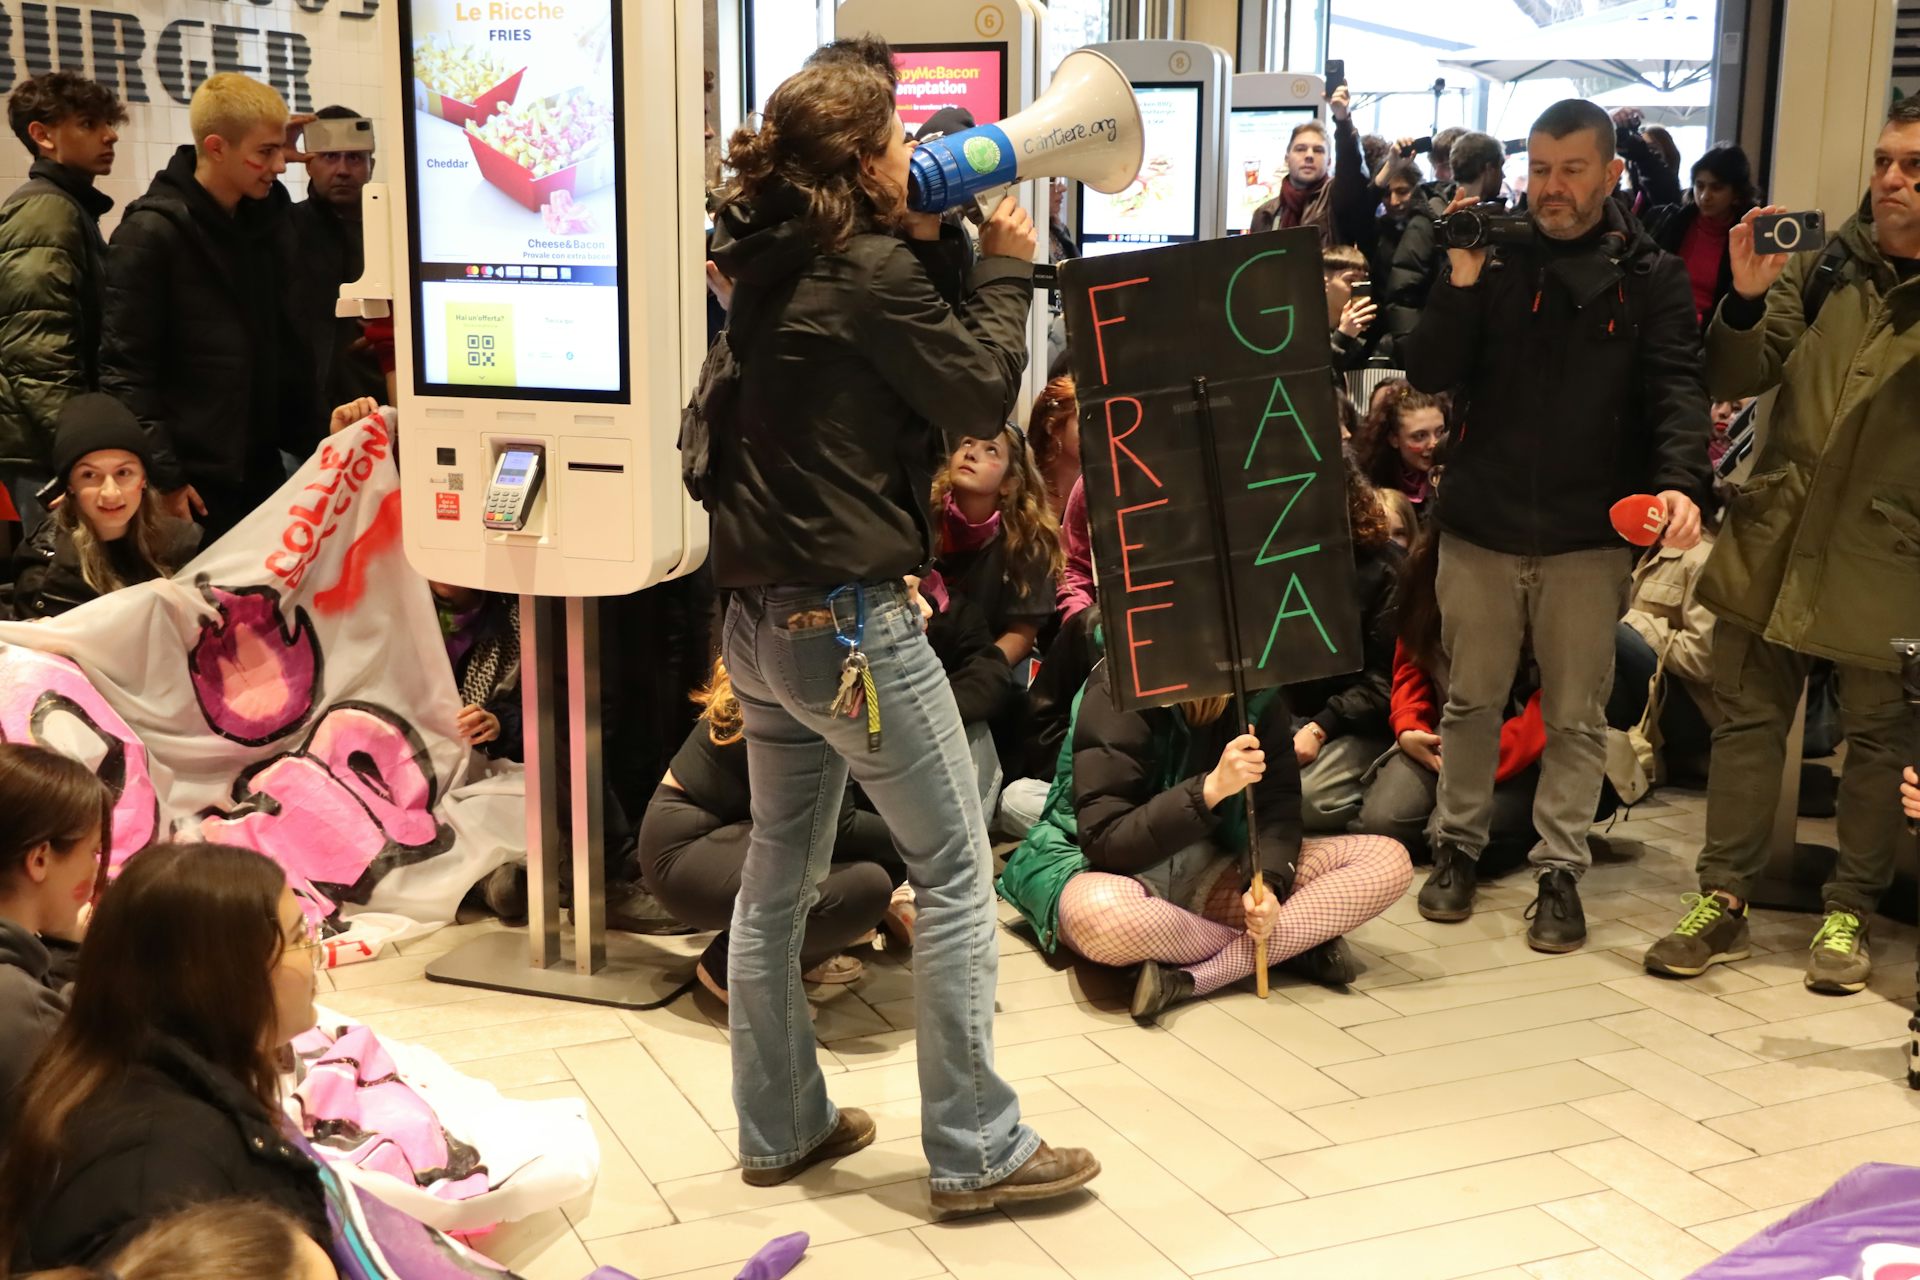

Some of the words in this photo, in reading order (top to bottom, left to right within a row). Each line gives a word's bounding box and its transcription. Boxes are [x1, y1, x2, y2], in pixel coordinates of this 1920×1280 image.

[456, 2, 481, 21] Le
[489, 1, 564, 20] Ricche
[984, 14, 994, 28] 6
[489, 29, 532, 41] FRIES
[0, 2, 314, 113] URGER
[1175, 57, 1184, 69] 8
[1294, 83, 1306, 93] 10
[426, 159, 469, 169] Cheddar
[528, 239, 605, 249] Cheese&Bacon
[523, 251, 550, 259] Provale
[1226, 249, 1339, 669] GAZA
[1088, 277, 1188, 698] FREE
